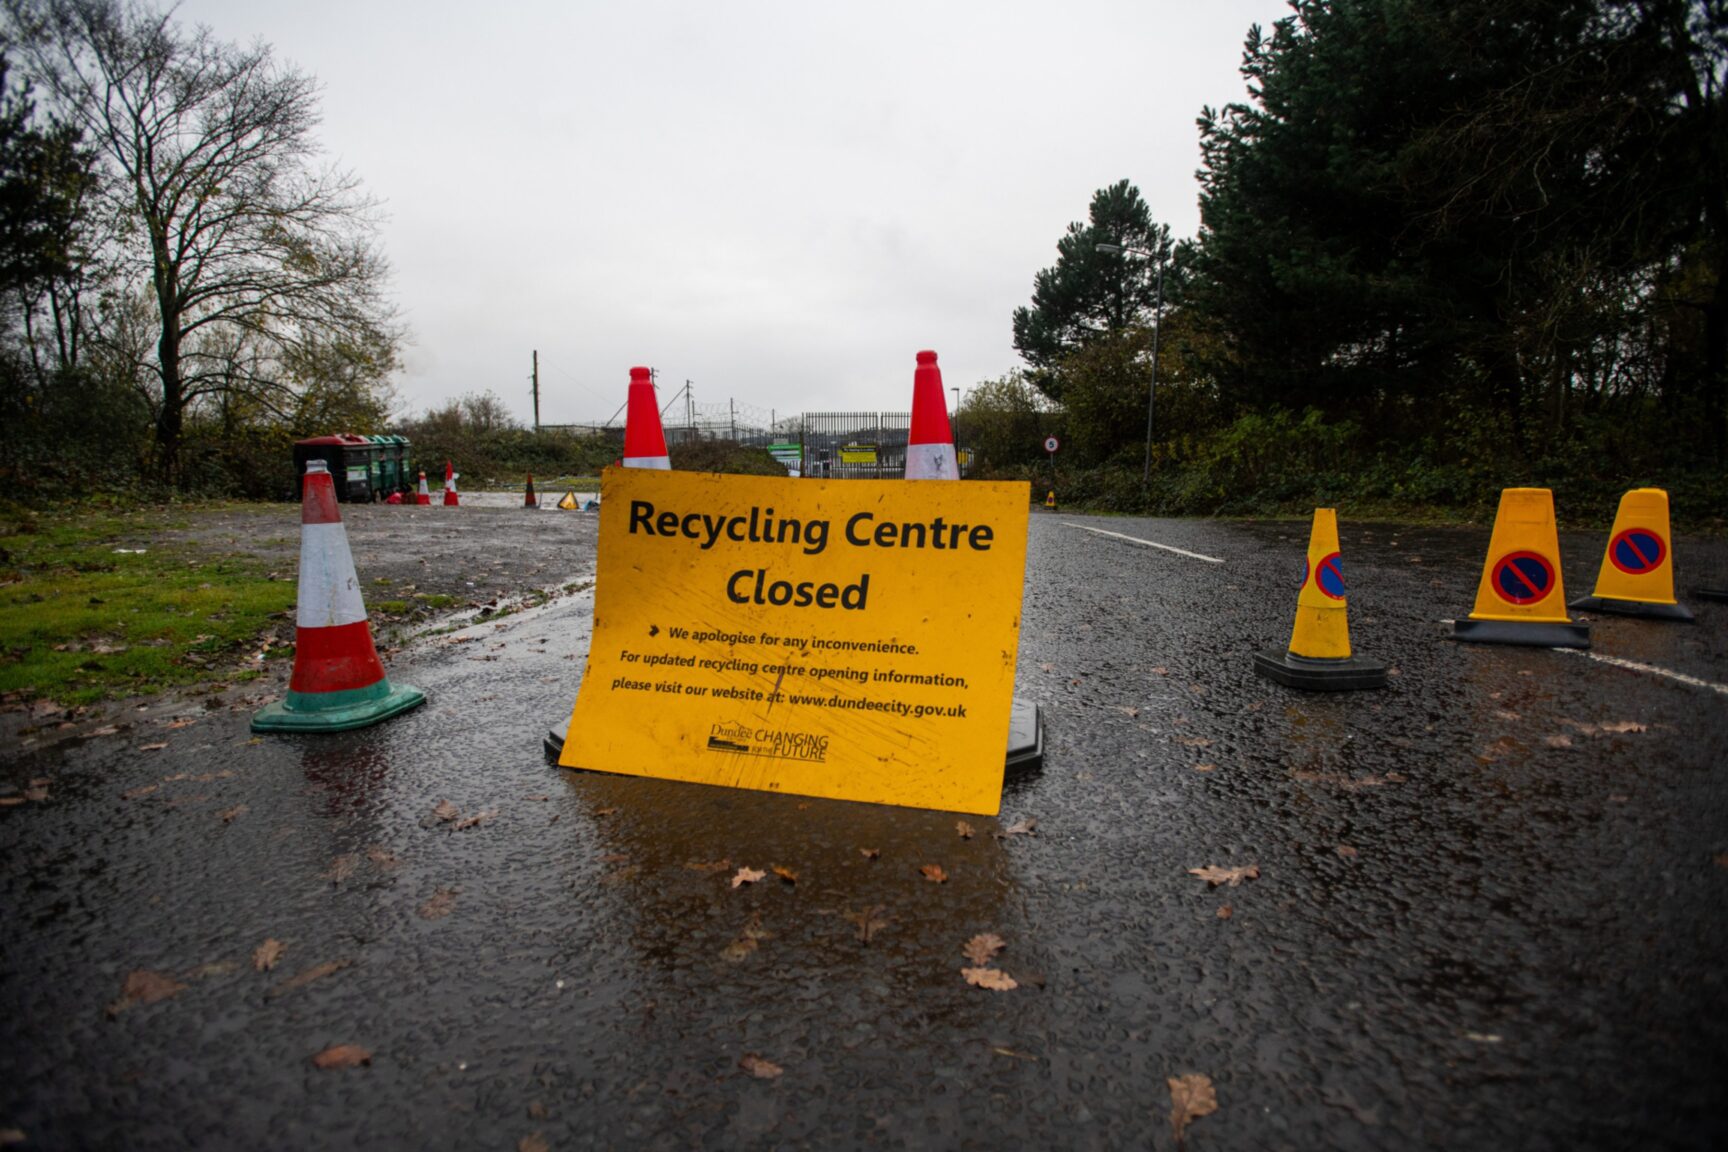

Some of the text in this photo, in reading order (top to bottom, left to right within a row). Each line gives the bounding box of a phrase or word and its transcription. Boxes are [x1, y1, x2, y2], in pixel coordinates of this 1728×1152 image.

[628, 500, 995, 555] Recycling Centre
[727, 569, 870, 610] Closed
[668, 626, 919, 655] We apologise for any inconvenience.
[620, 650, 969, 690] For updated recycling centre opening information,
[611, 676, 967, 719] please visit our website at: www.dundeecity.gov.uk
[710, 723, 829, 751] Dundee CHANGING
[773, 742, 826, 760] FUTURE
